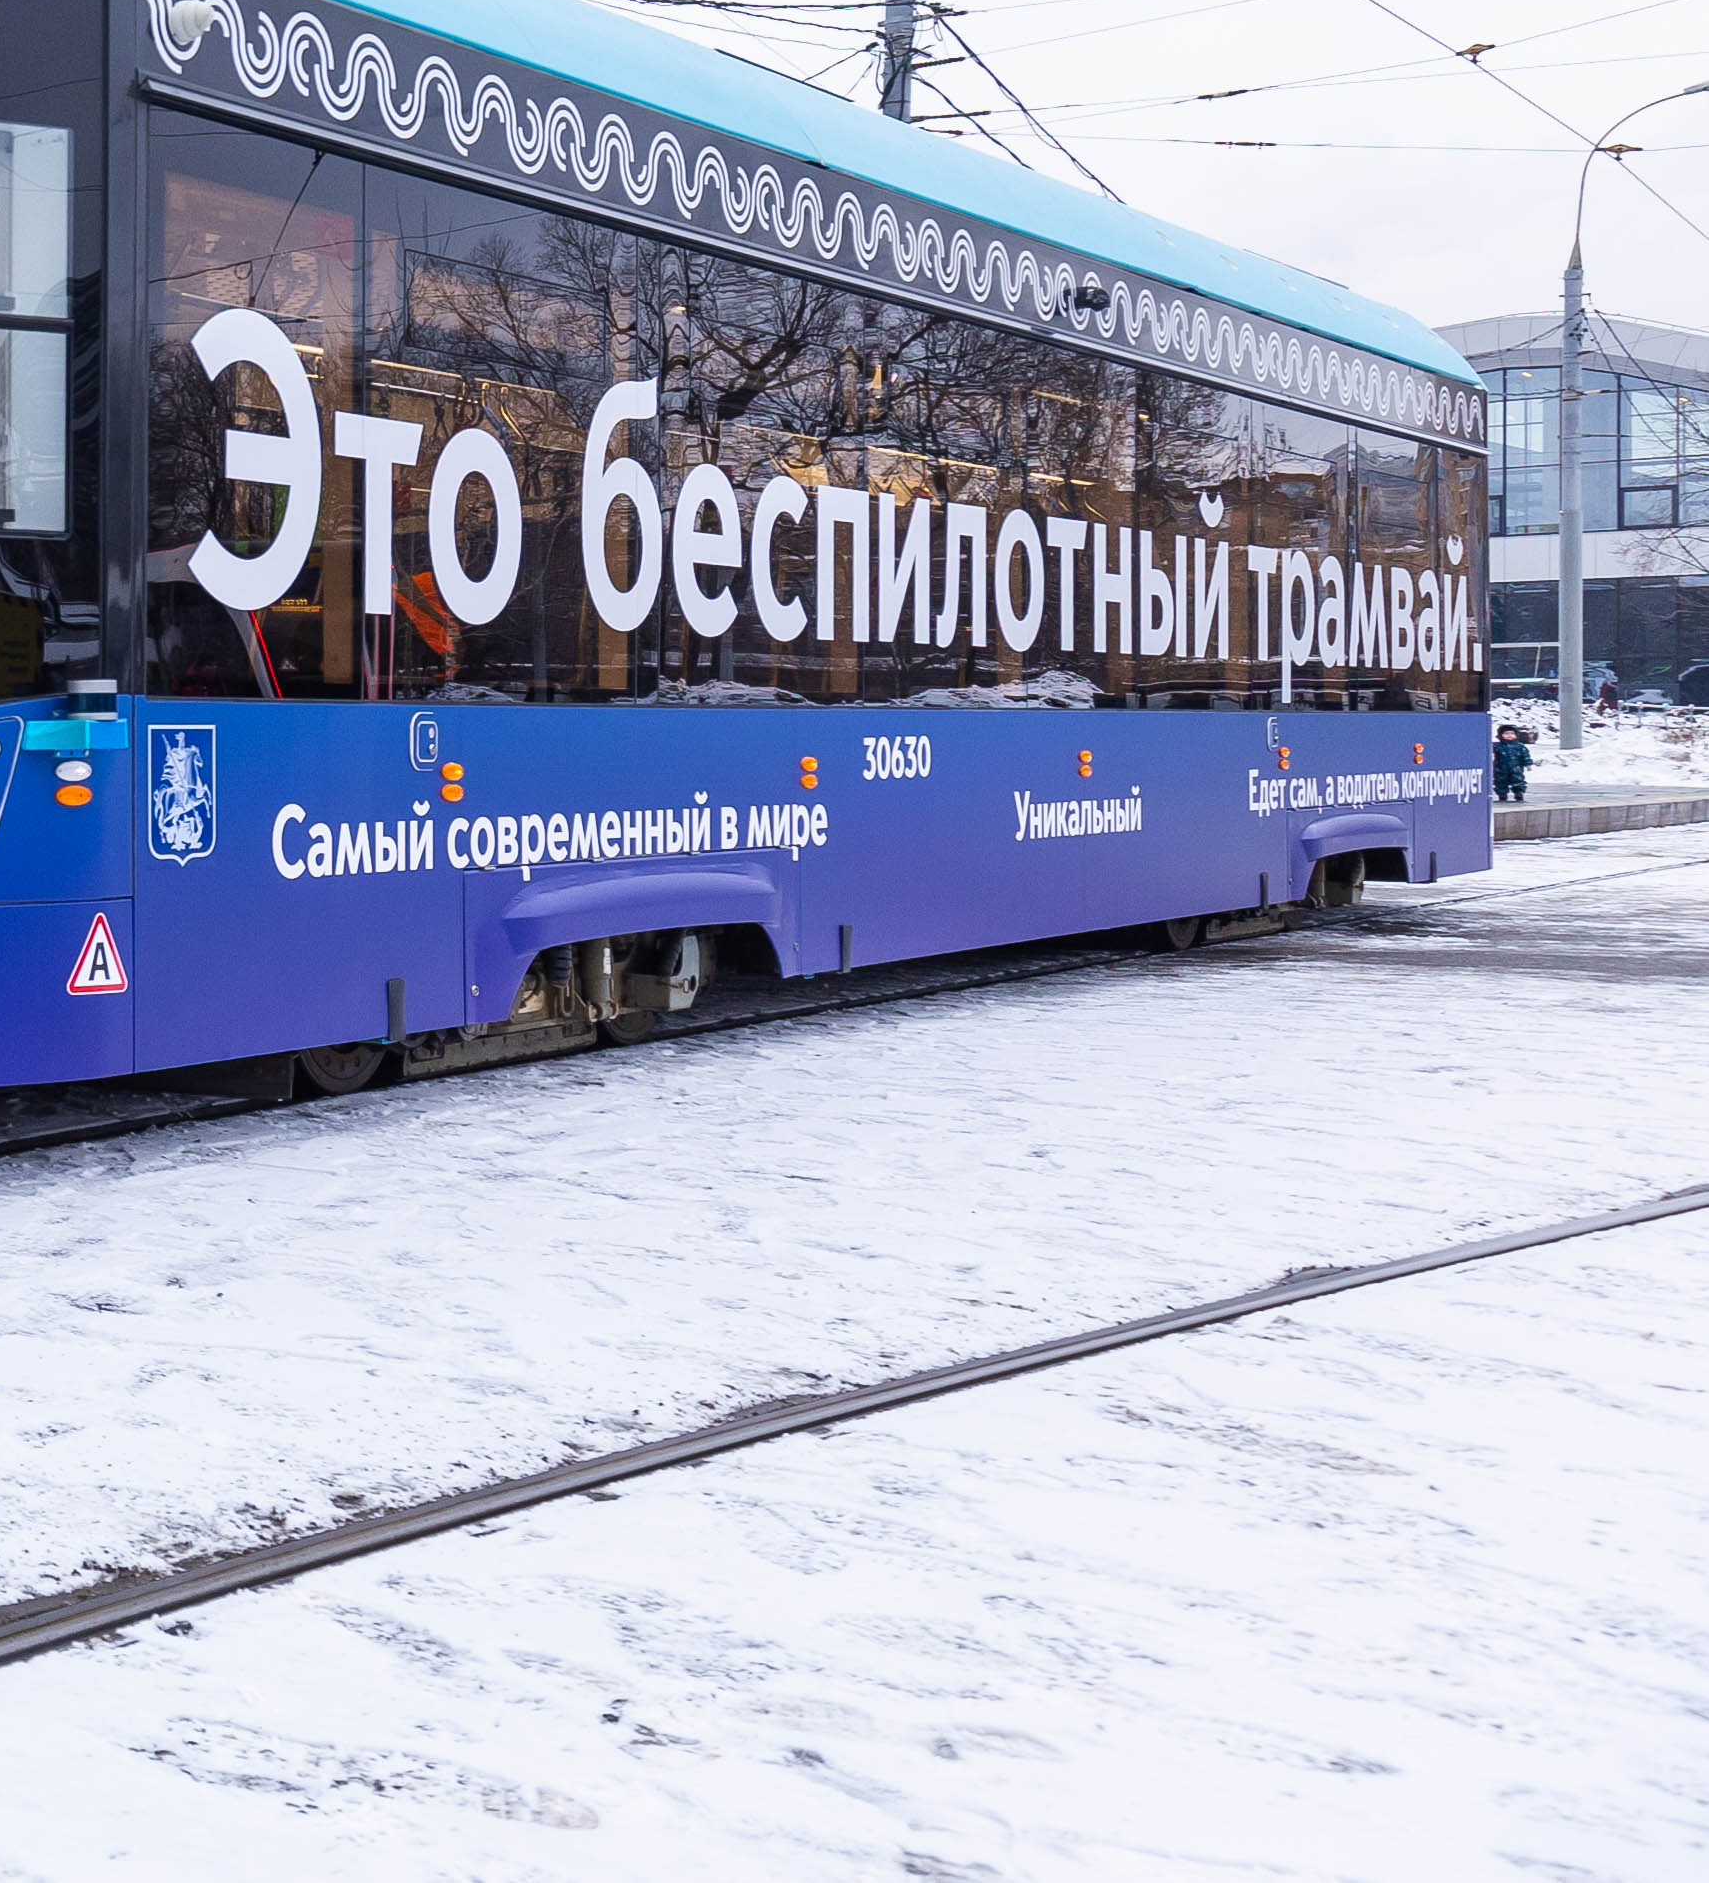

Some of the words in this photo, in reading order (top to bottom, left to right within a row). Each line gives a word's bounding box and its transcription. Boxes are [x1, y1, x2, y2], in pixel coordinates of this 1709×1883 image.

[188, 308, 522, 626] Это
[582, 376, 1230, 660] беспилотный
[1248, 534, 1484, 704] трамвай.
[862, 734, 932, 781] 30630
[1014, 786, 1143, 842] Уникальный
[1248, 769, 1286, 817] Едет
[1289, 778, 1323, 814] сам,
[1325, 778, 1335, 805] а
[1337, 772, 1400, 810] водитель
[1401, 767, 1484, 808] контролирует
[272, 799, 435, 880] Самый
[447, 790, 711, 881] современный
[721, 805, 738, 848] в
[747, 799, 829, 862] мире
[88, 942, 111, 982] А
